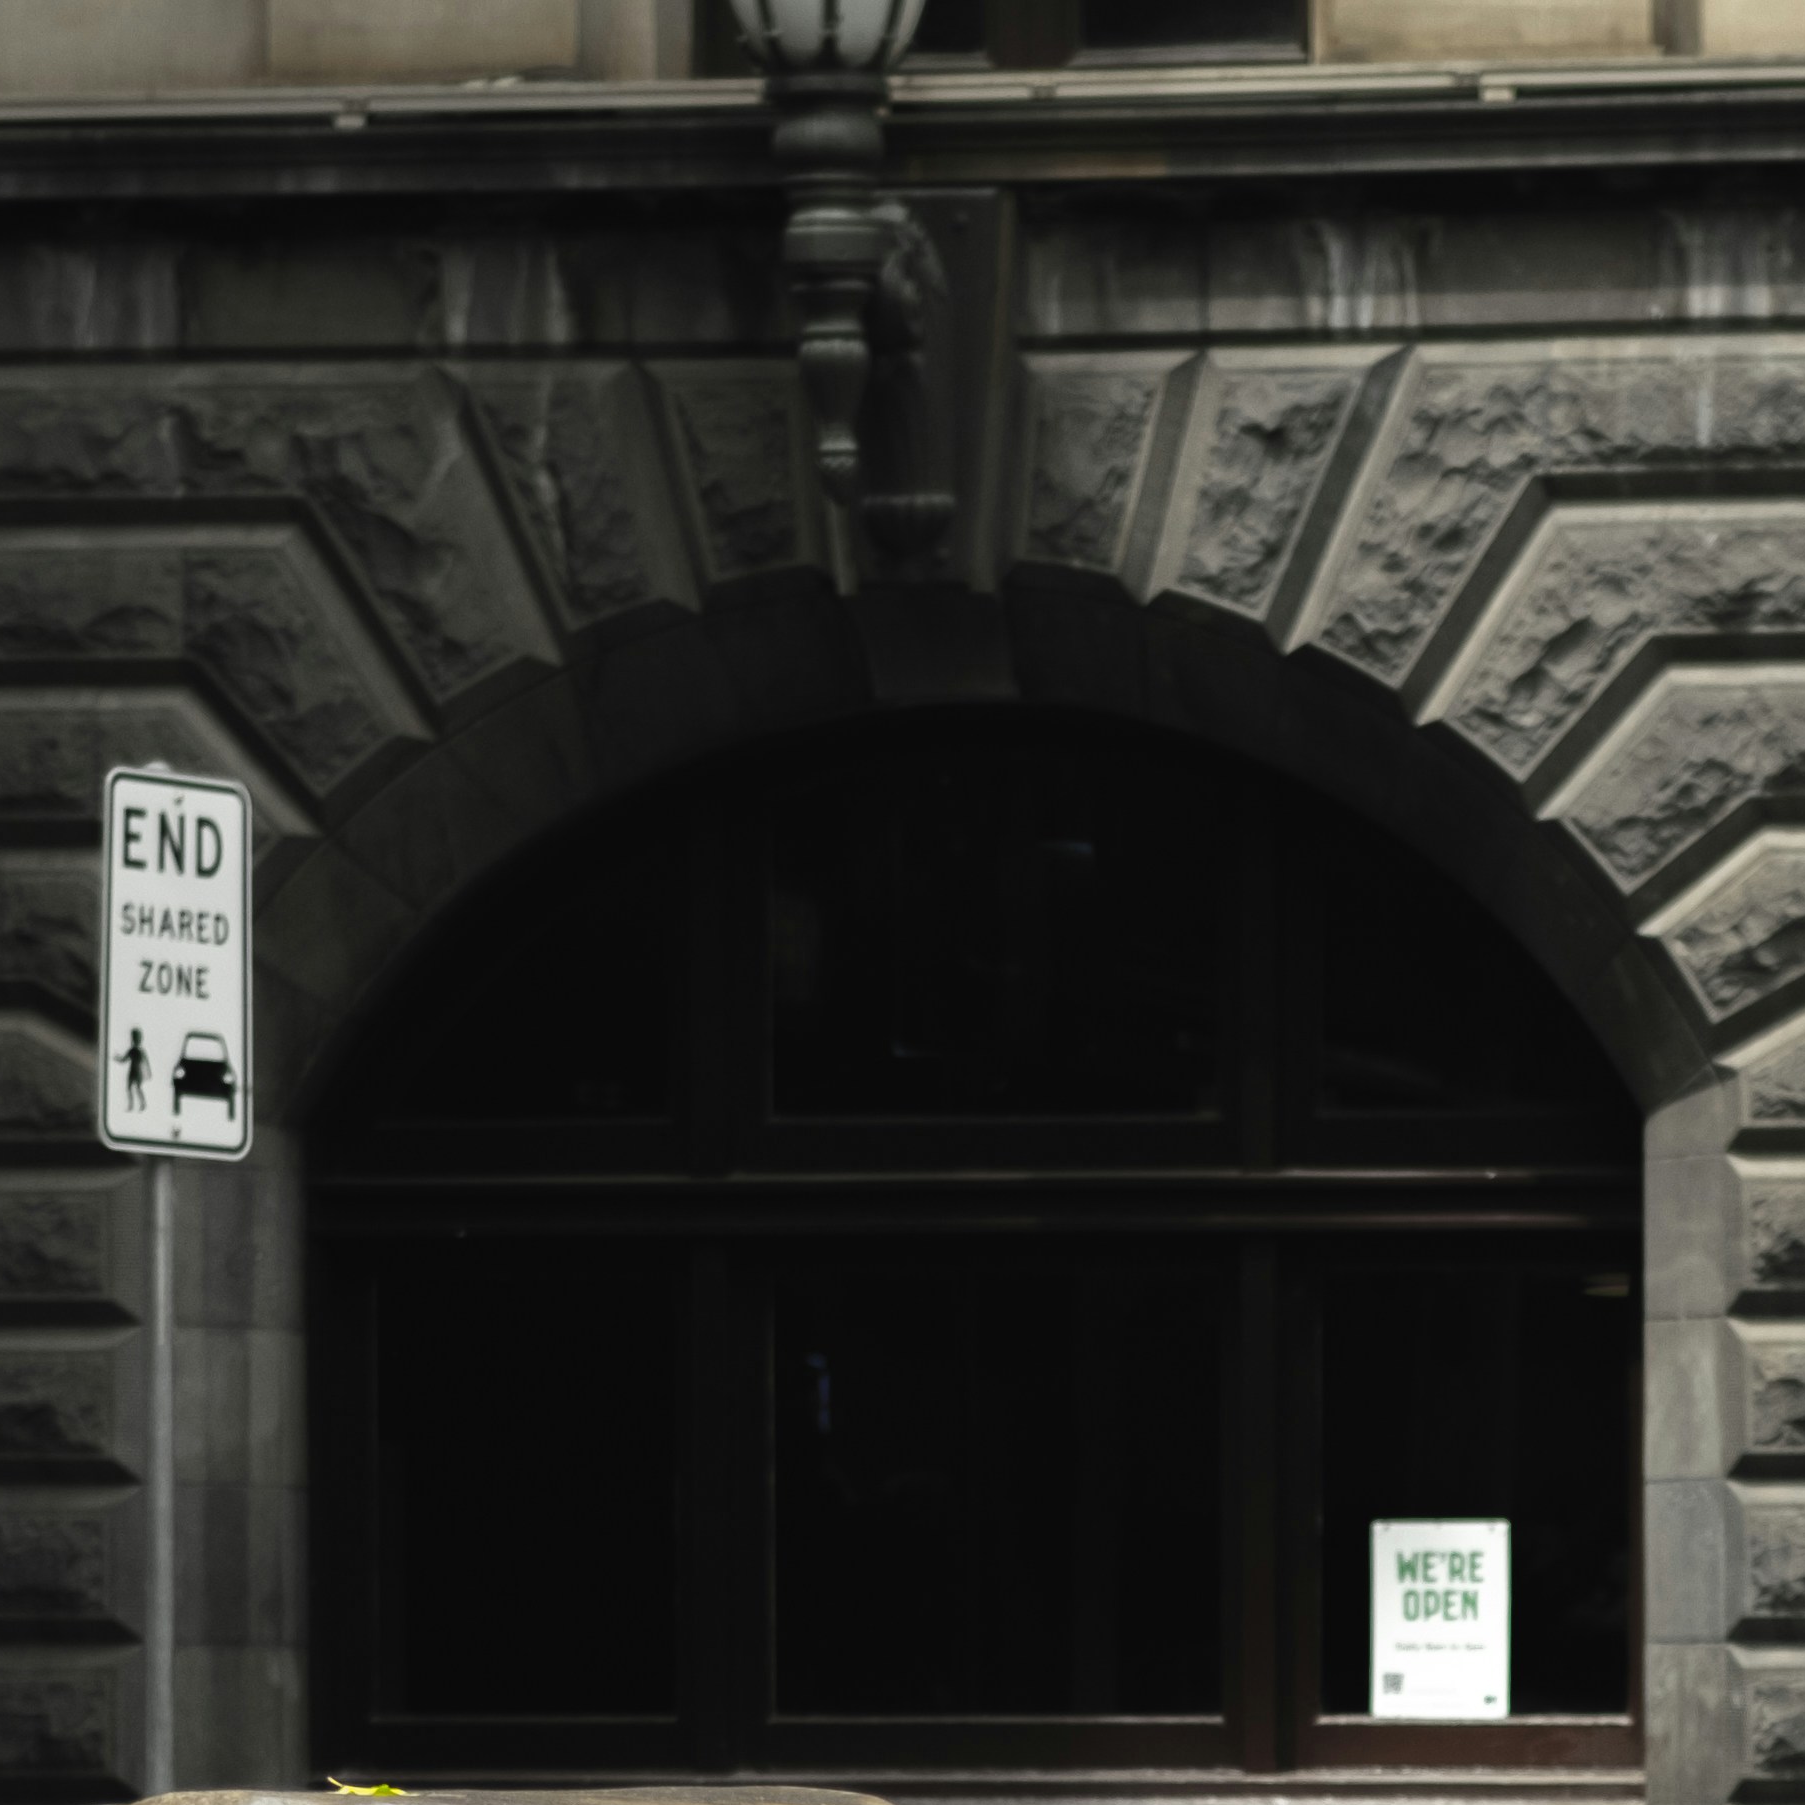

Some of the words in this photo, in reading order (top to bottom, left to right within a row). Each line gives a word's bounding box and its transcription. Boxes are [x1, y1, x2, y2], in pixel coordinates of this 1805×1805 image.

[122, 806, 224, 879] END
[119, 903, 231, 947] SHARED
[138, 960, 211, 1001] ZONE
[1395, 1550, 1485, 1584] WE'RE
[1402, 1588, 1480, 1622] OPEN
